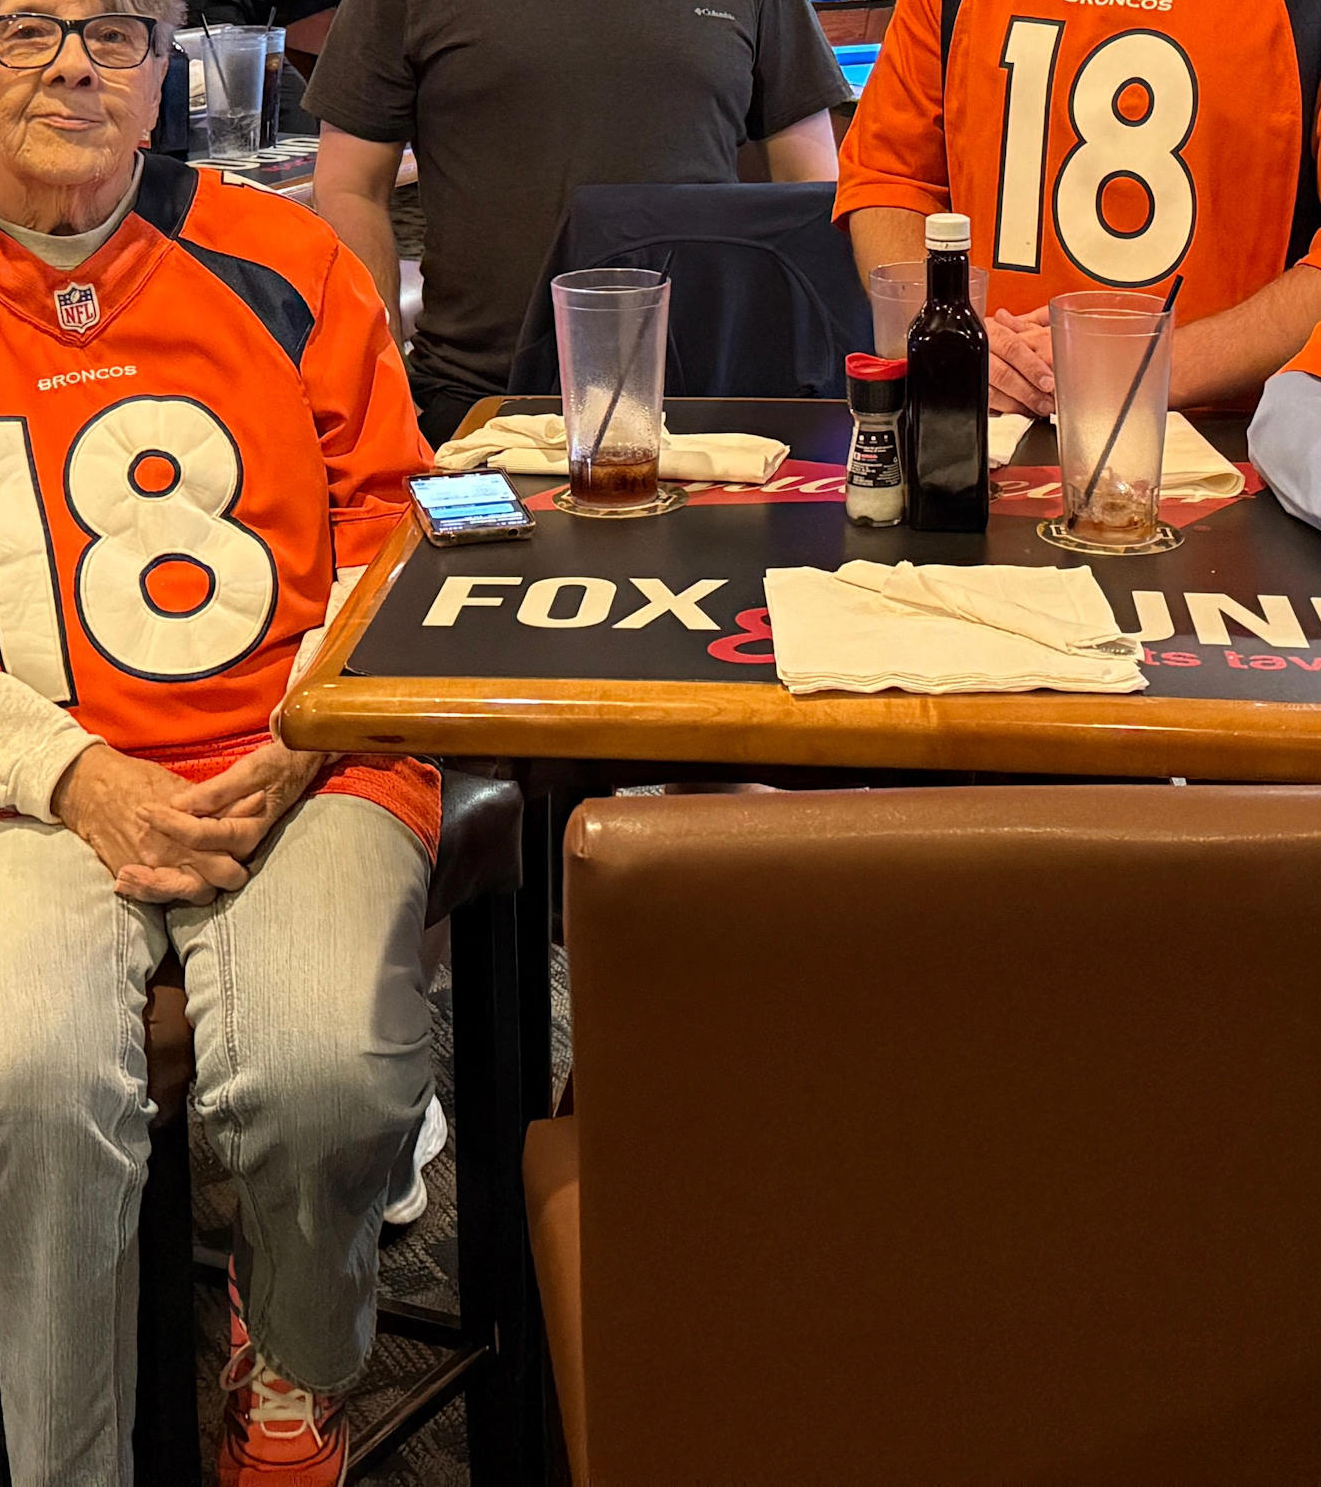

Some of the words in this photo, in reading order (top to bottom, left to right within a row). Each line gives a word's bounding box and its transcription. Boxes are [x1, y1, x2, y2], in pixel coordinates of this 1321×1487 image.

[992, 15, 1199, 289] 18
[64, 302, 94, 325] NFL
[38, 365, 138, 392] BRONCOS
[422, 575, 729, 631] FOX
